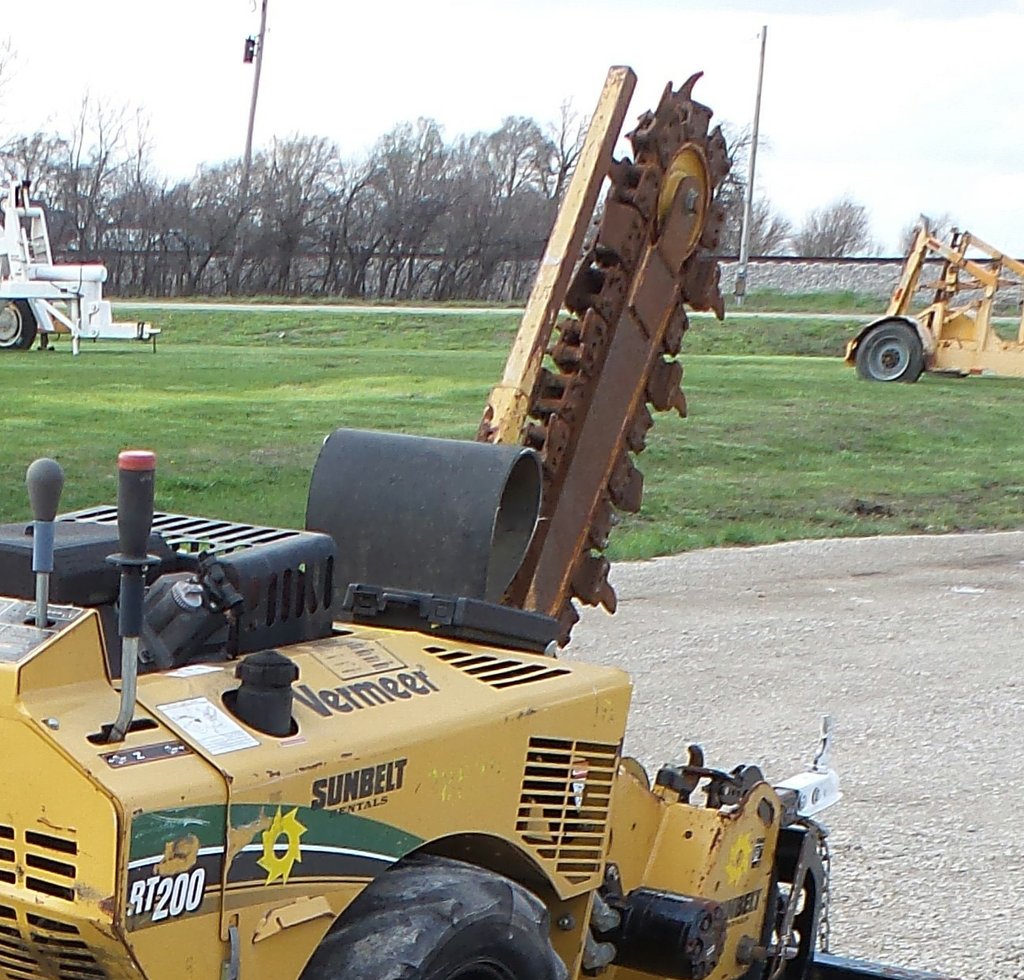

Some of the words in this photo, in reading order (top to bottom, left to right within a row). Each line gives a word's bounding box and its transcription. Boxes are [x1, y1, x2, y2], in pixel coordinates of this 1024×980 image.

[293, 669, 441, 717] Vermeer
[311, 758, 408, 811] SUNBELT
[127, 867, 206, 922] RT200
